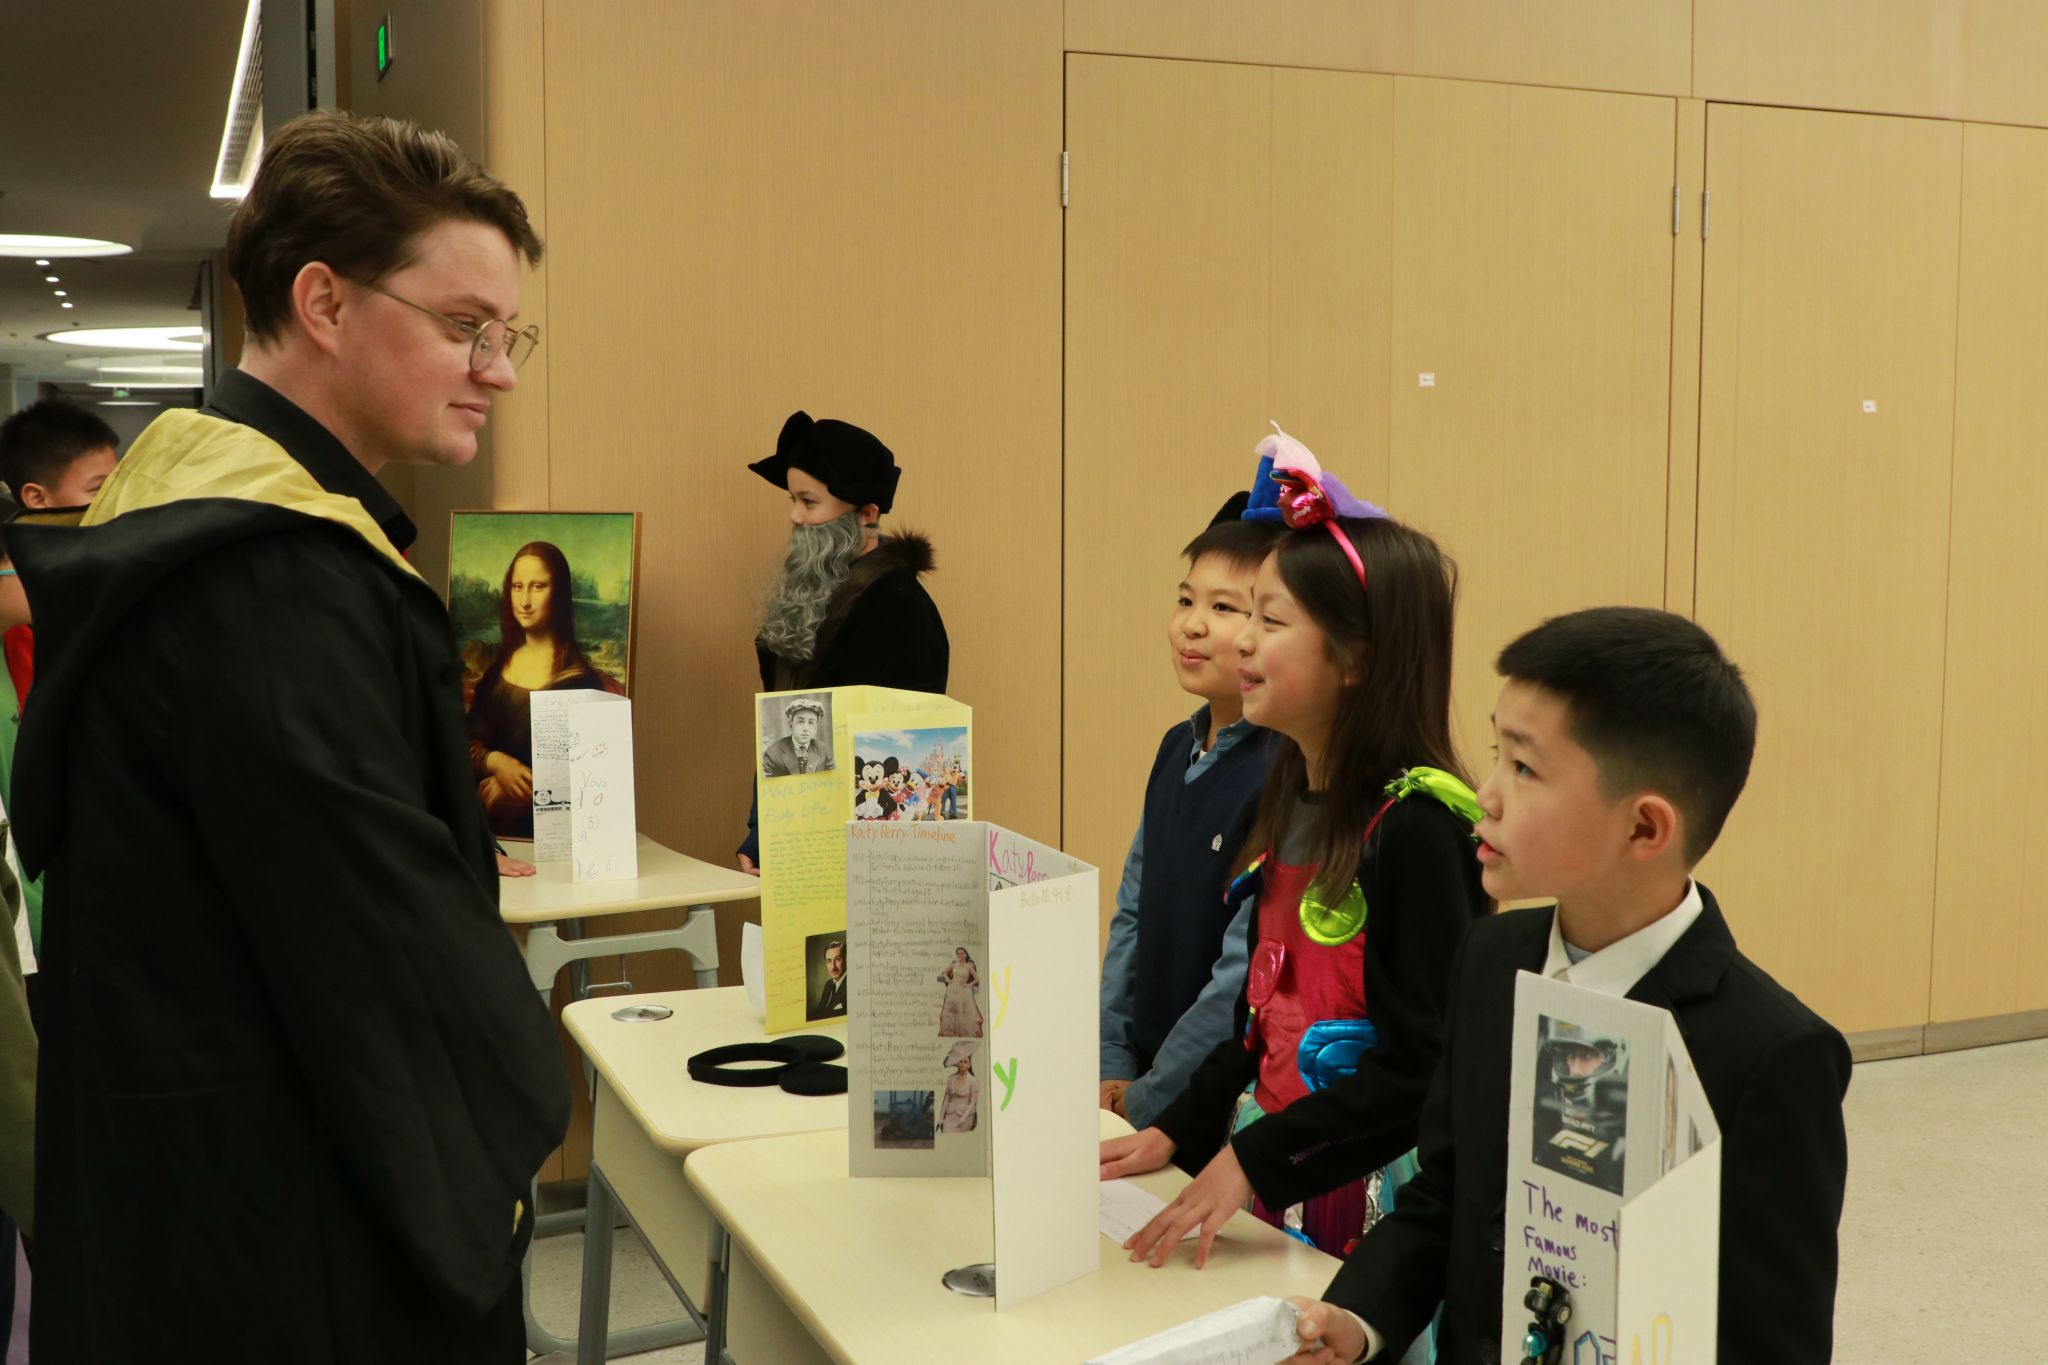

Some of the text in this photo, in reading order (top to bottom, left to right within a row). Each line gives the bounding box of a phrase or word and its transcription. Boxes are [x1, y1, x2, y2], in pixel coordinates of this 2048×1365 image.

[851, 823, 956, 844] Katy Perry Timeline
[989, 830, 1026, 878] Katy
[1522, 1180, 1618, 1252] The most
[1524, 1225, 1577, 1261] Famous
[1528, 1256, 1587, 1288] Movie:
